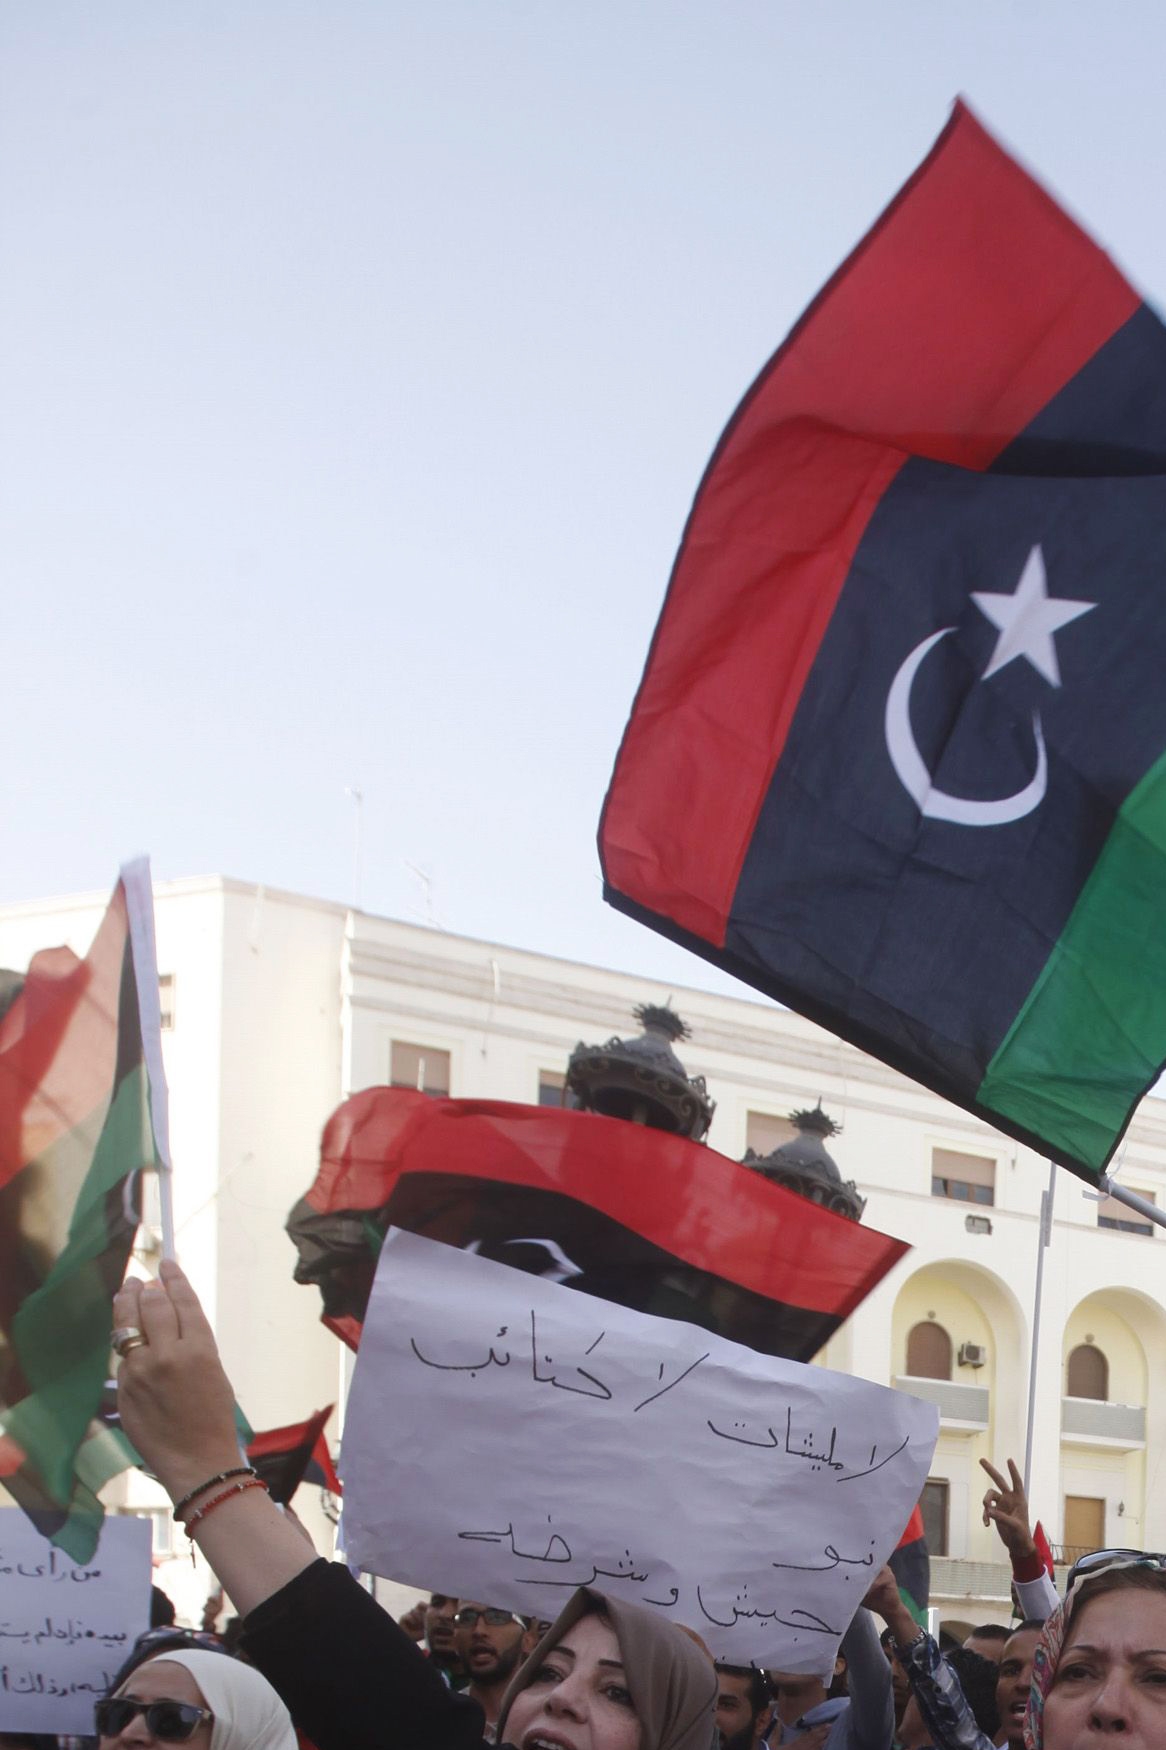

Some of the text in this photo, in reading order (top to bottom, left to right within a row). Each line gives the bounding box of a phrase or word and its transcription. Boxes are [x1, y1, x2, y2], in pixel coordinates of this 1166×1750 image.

[409, 1309, 613, 1400] كتائب
[634, 1352, 710, 1413] لا
[836, 1435, 910, 1483] لا
[696, 1583, 843, 1643] جيش
